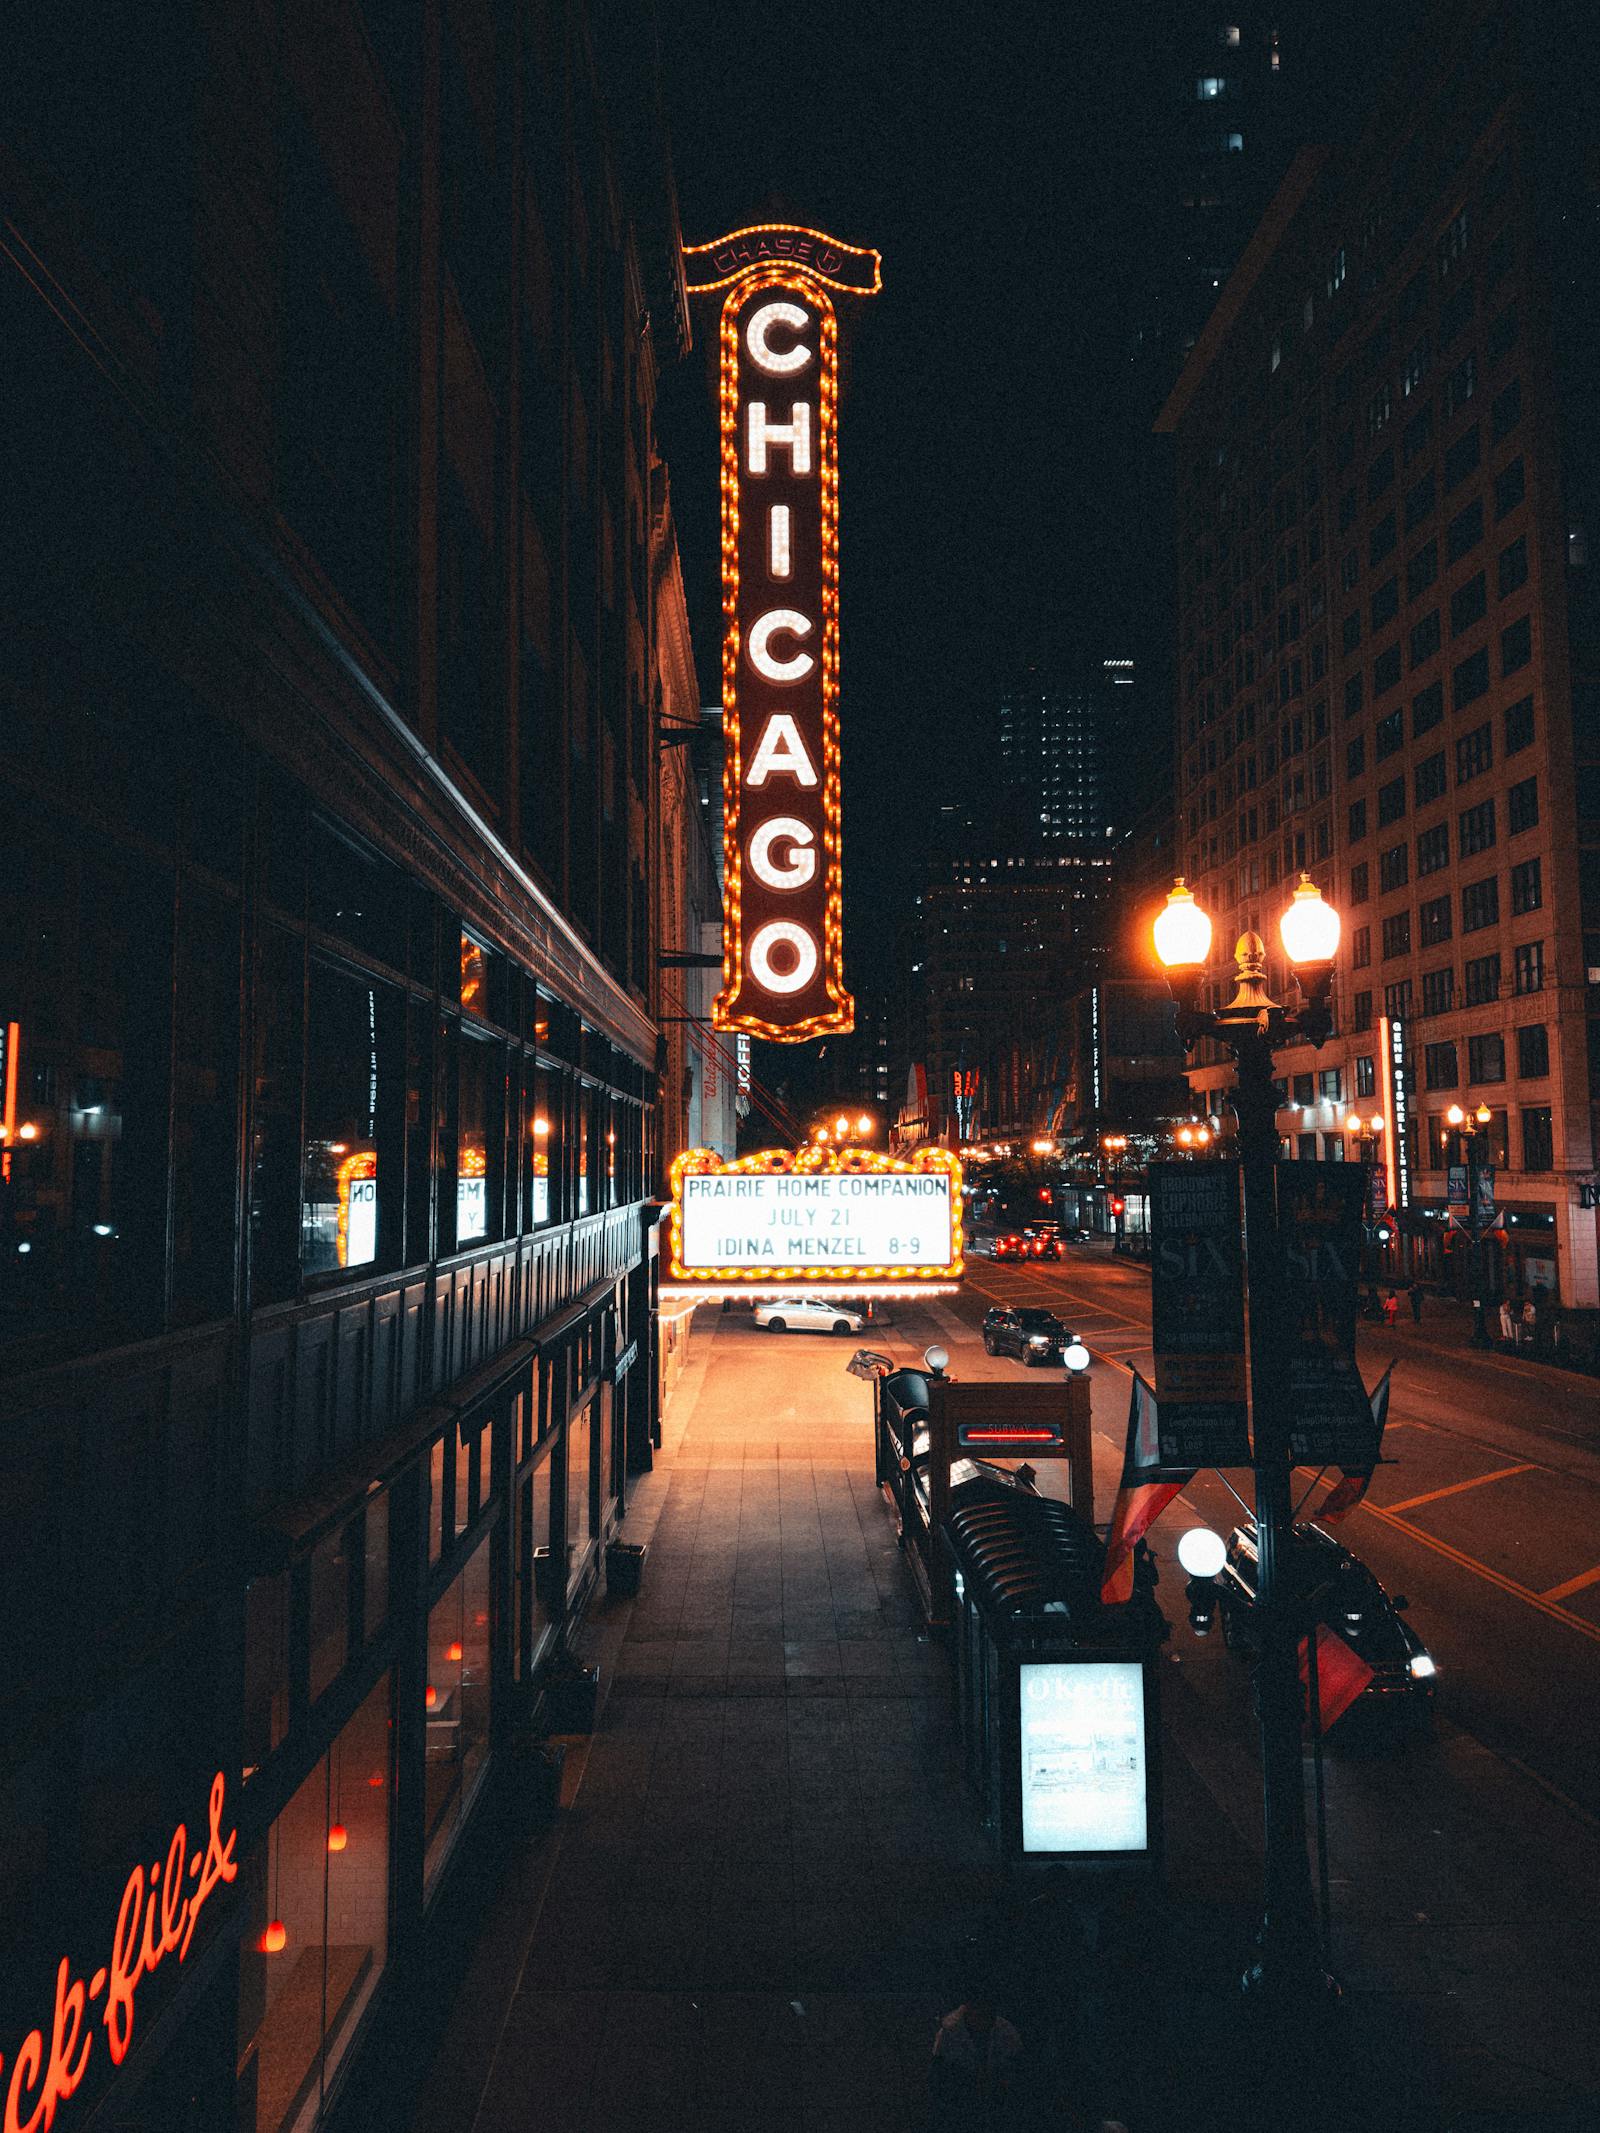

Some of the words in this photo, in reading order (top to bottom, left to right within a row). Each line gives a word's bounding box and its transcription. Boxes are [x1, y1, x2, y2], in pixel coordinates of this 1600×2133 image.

[713, 240, 814, 272] CHASE
[746, 302, 817, 993] CHICAGO
[1392, 1021, 1403, 1064] GENE
[1394, 1069, 1406, 1134] SISKEL
[689, 1178, 765, 1198] PRAIRIE
[777, 1178, 831, 1197] HOME
[838, 1177, 947, 1197] COMPANION
[767, 1209, 816, 1226] JULY
[830, 1208, 850, 1226] 21
[717, 1237, 774, 1256] IDINA
[788, 1237, 867, 1256] MENZEL
[888, 1237, 921, 1255] 8-9
[1159, 1236, 1232, 1279] SIX
